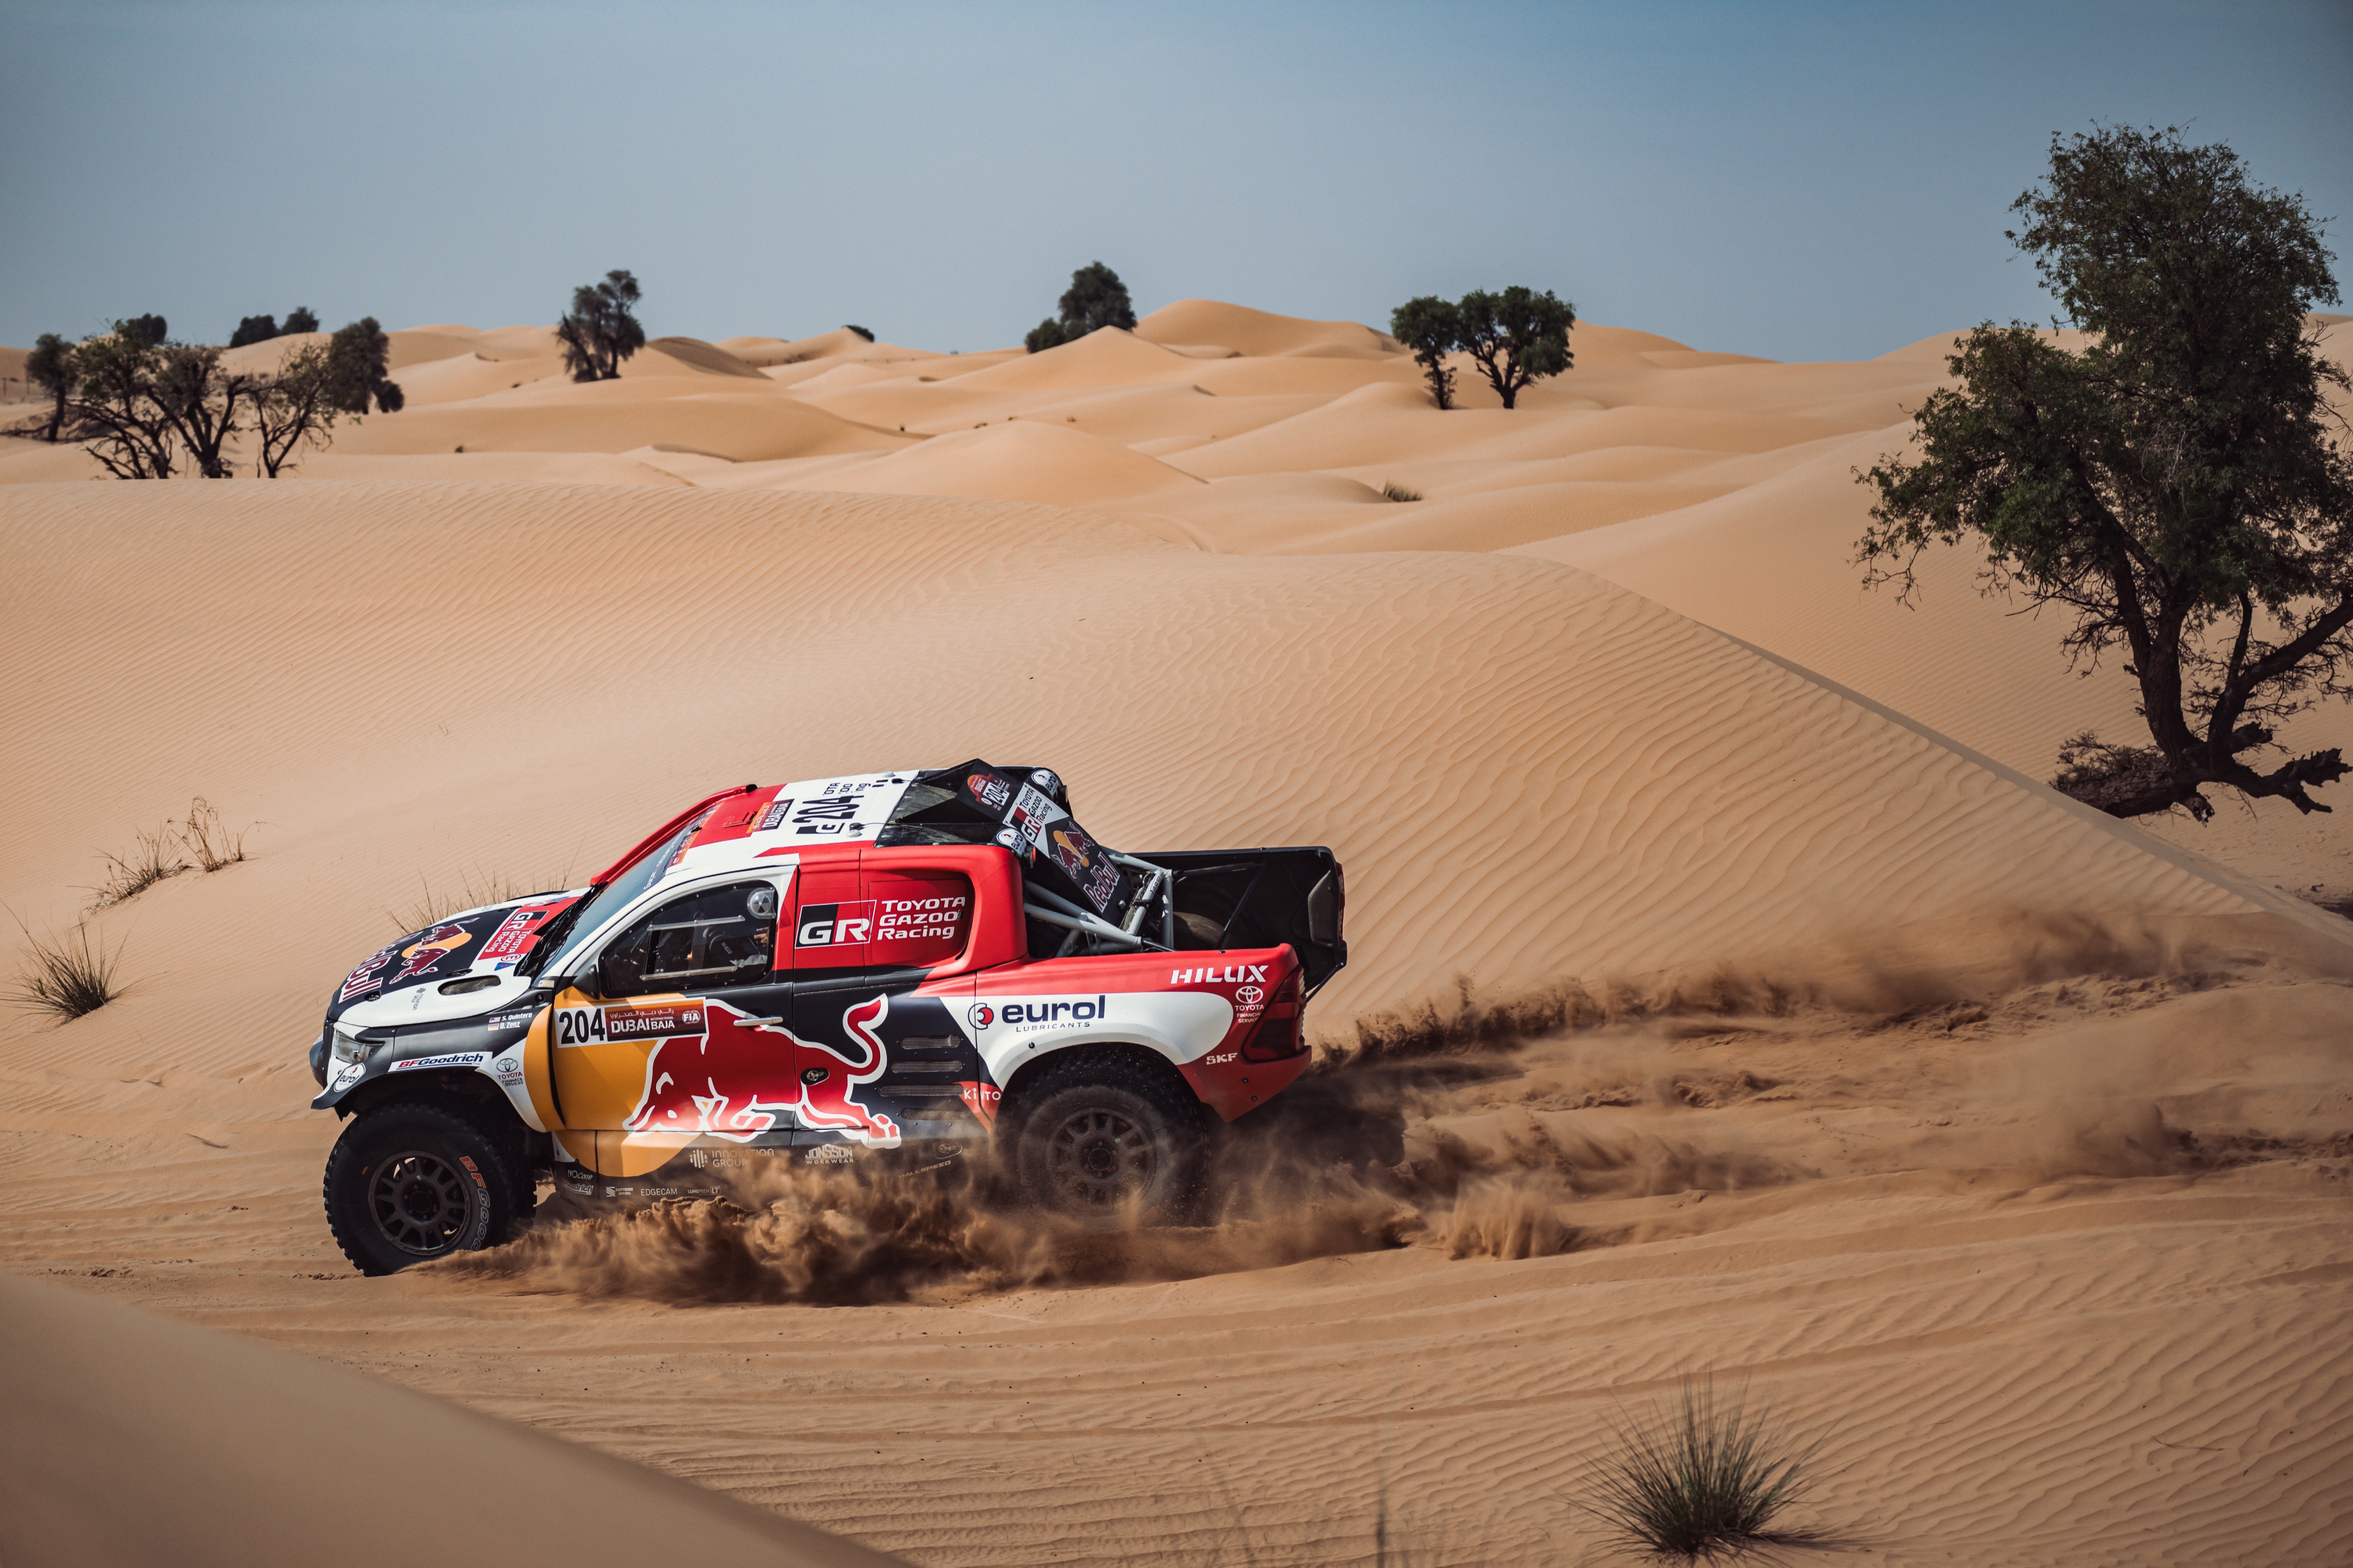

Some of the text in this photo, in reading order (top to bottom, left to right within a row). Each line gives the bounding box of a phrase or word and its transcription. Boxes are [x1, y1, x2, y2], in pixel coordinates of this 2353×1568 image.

[1045, 773, 1057, 791] eurol
[985, 785, 1007, 804] 204
[1020, 787, 1036, 809] TOYOTA
[792, 795, 865, 823] 204
[1028, 795, 1043, 817] GAZOO
[1036, 802, 1053, 824] Racing
[1021, 816, 1043, 841] GR
[1011, 831, 1024, 850] eurol
[882, 897, 966, 912] TOYOTA
[507, 912, 534, 930] GR
[879, 912, 958, 927] GAZOO
[799, 918, 870, 945] GR
[877, 925, 955, 940] Racing
[485, 931, 506, 953] Racing
[497, 930, 516, 952] GAZOO
[507, 930, 531, 953] TOYOTA
[1170, 965, 1269, 984] HILUX
[508, 1013, 533, 1021] Quintero
[1001, 995, 1105, 1024] eurol
[559, 1008, 605, 1045] 204
[611, 1018, 650, 1034] DUBAI
[651, 1019, 676, 1030] BAJA
[1016, 1021, 1090, 1033] LUBRICANTS
[398, 1053, 484, 1068] BFGoodrich
[1206, 1052, 1238, 1065] SKF
[340, 1073, 359, 1084] eurol
[497, 1071, 523, 1080] TOYOTA
[805, 1143, 853, 1158] JONSSON
[641, 1188, 678, 1196] EDGECAM
